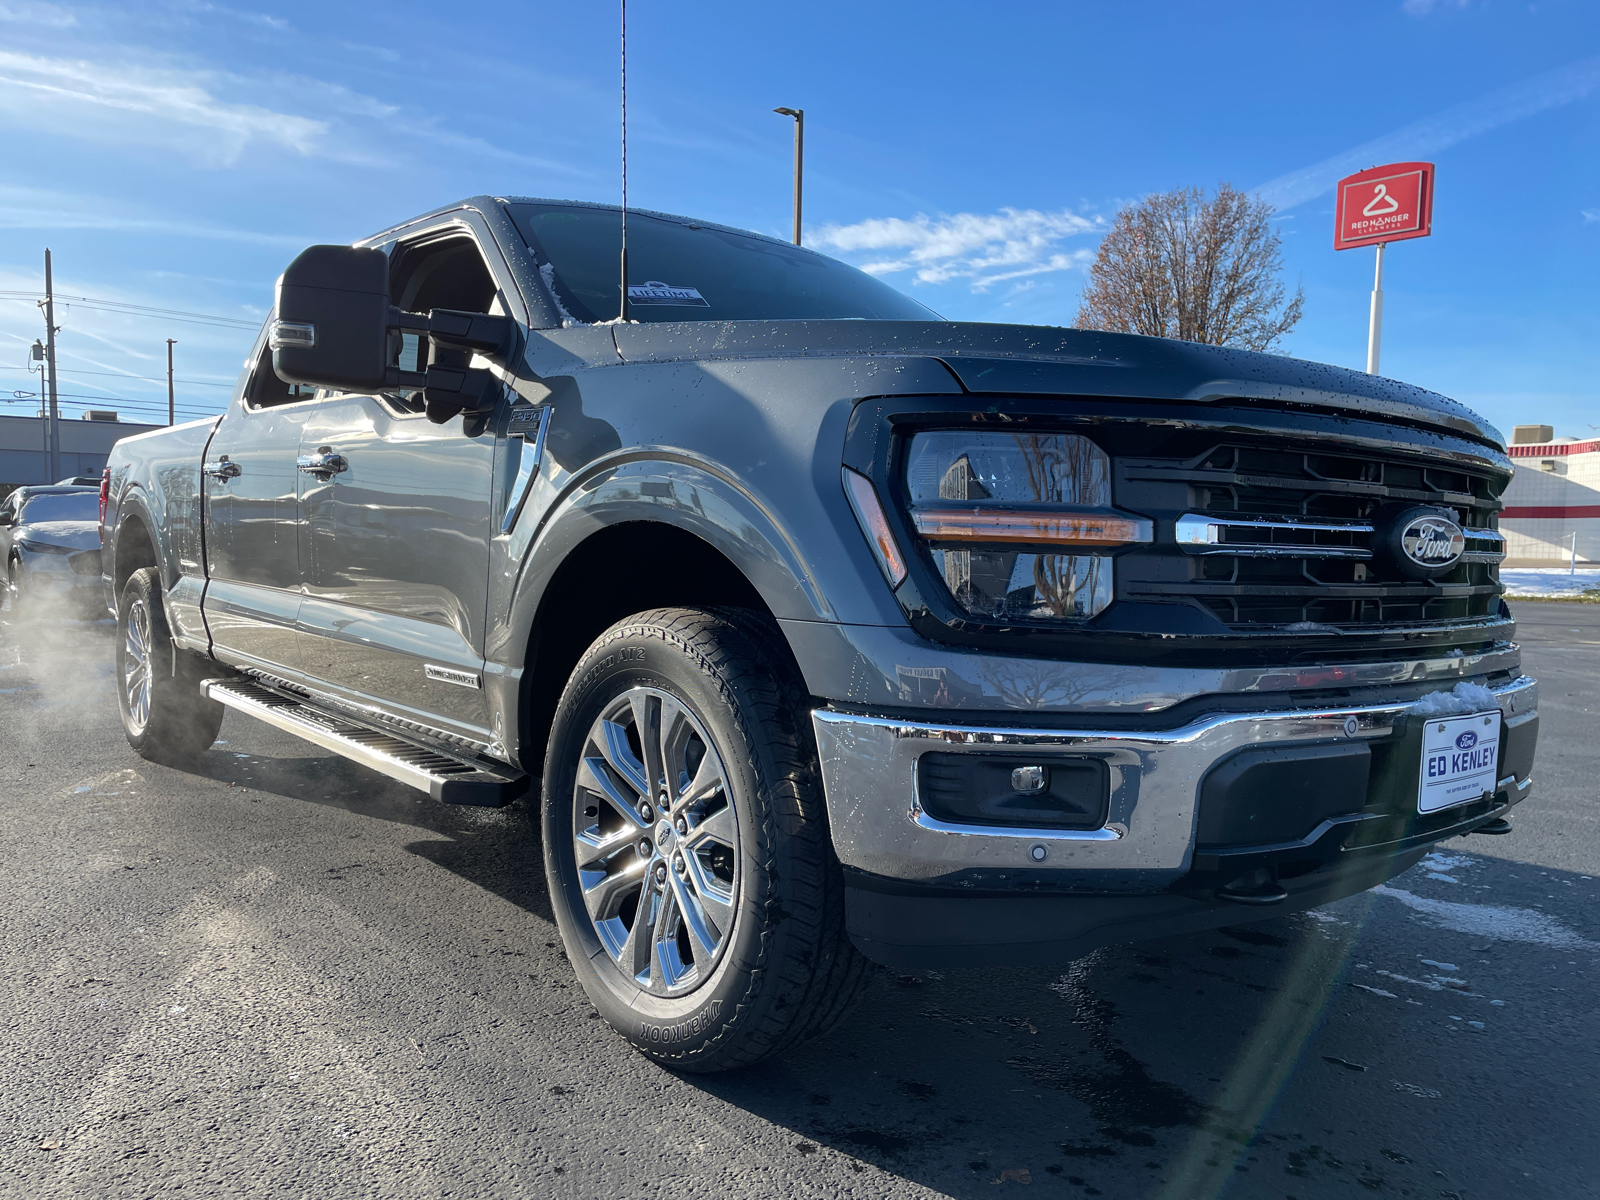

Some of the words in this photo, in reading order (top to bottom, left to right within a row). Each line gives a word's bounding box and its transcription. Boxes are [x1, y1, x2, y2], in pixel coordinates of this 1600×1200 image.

[1351, 221, 1369, 230] RED
[1370, 213, 1410, 226] HANGER
[1358, 223, 1401, 234] CLEANERS
[632, 290, 693, 298] LIFETIME
[1415, 523, 1454, 558] Ford
[1428, 756, 1447, 777] ED
[1452, 746, 1496, 773] KENLEY
